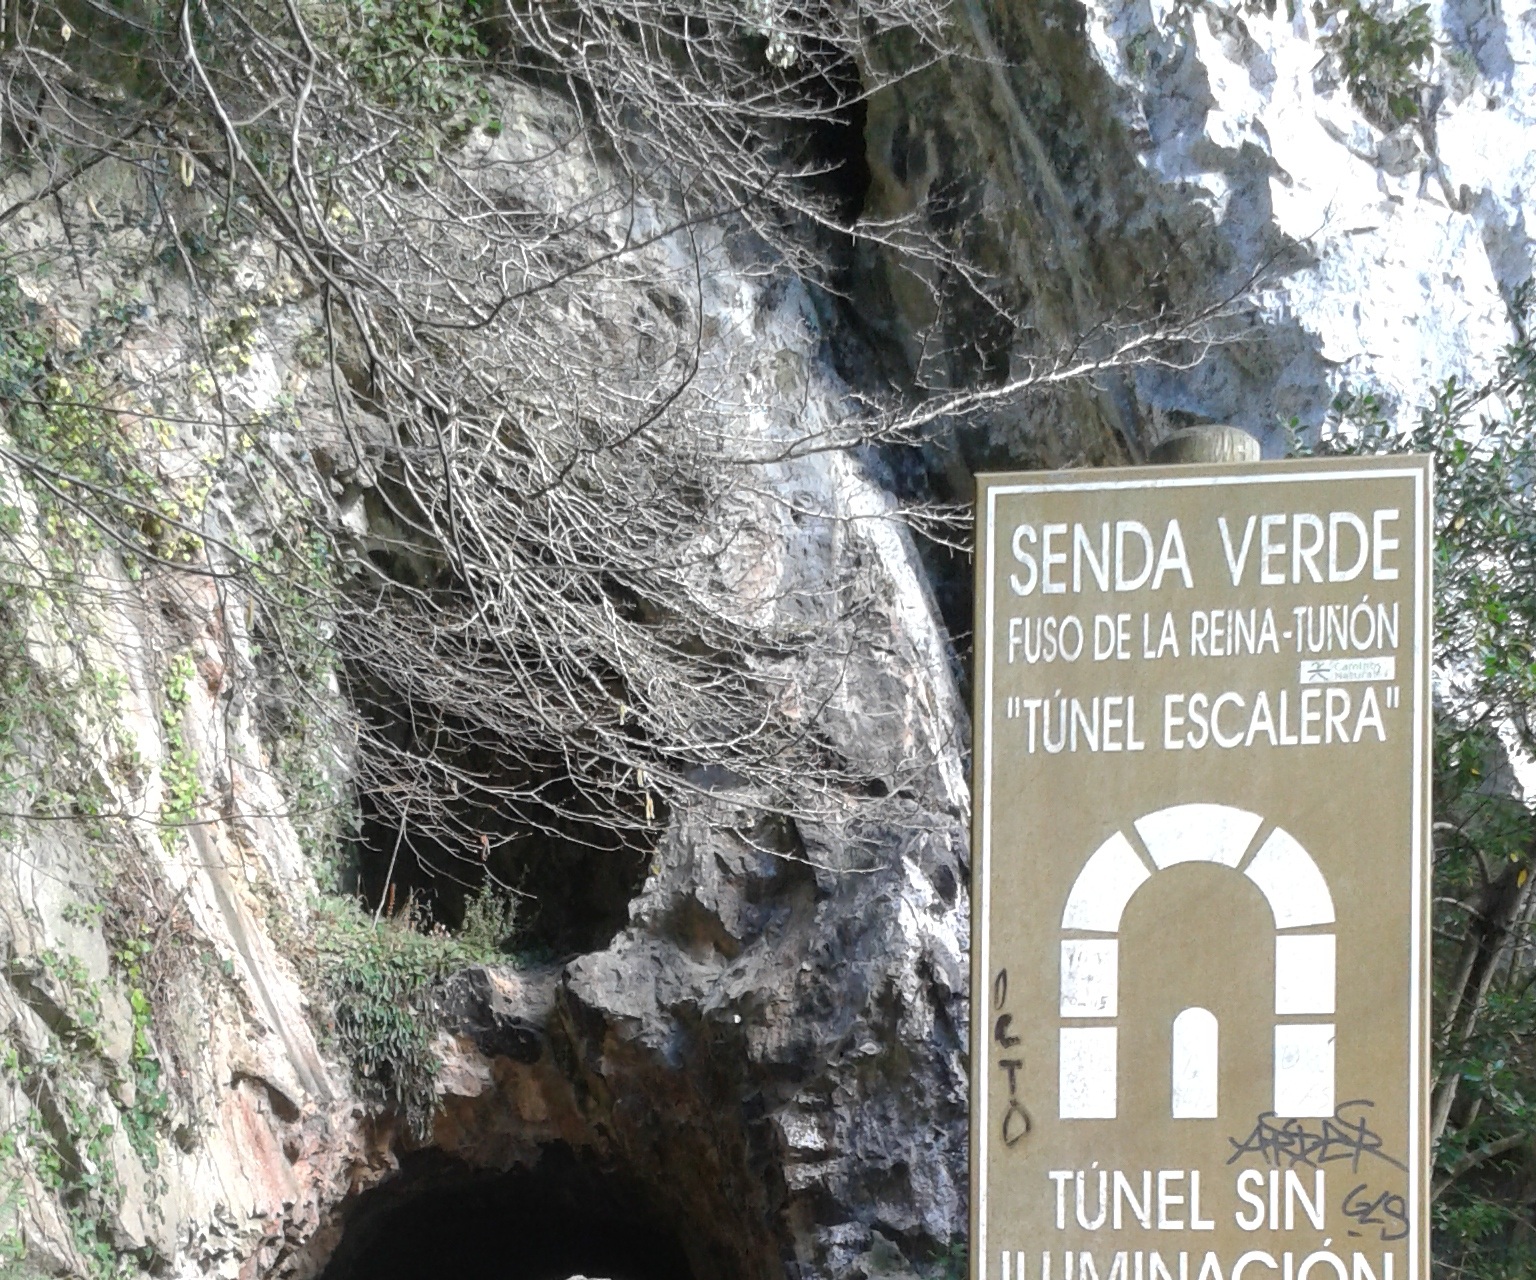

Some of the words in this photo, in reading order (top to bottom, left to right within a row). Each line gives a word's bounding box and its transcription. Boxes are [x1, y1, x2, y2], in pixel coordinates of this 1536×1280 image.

[1009, 518, 1195, 597] SENDA
[1217, 509, 1400, 587] VERDE
[1007, 615, 1084, 664] FUSO
[1093, 612, 1131, 661] DE
[1143, 611, 1179, 659] LA
[1007, 688, 1145, 755] "TÚNEL
[1163, 686, 1400, 750] ESCALERA"
[1048, 1161, 1215, 1231] TÚNEL
[1234, 1168, 1325, 1232] SIN
